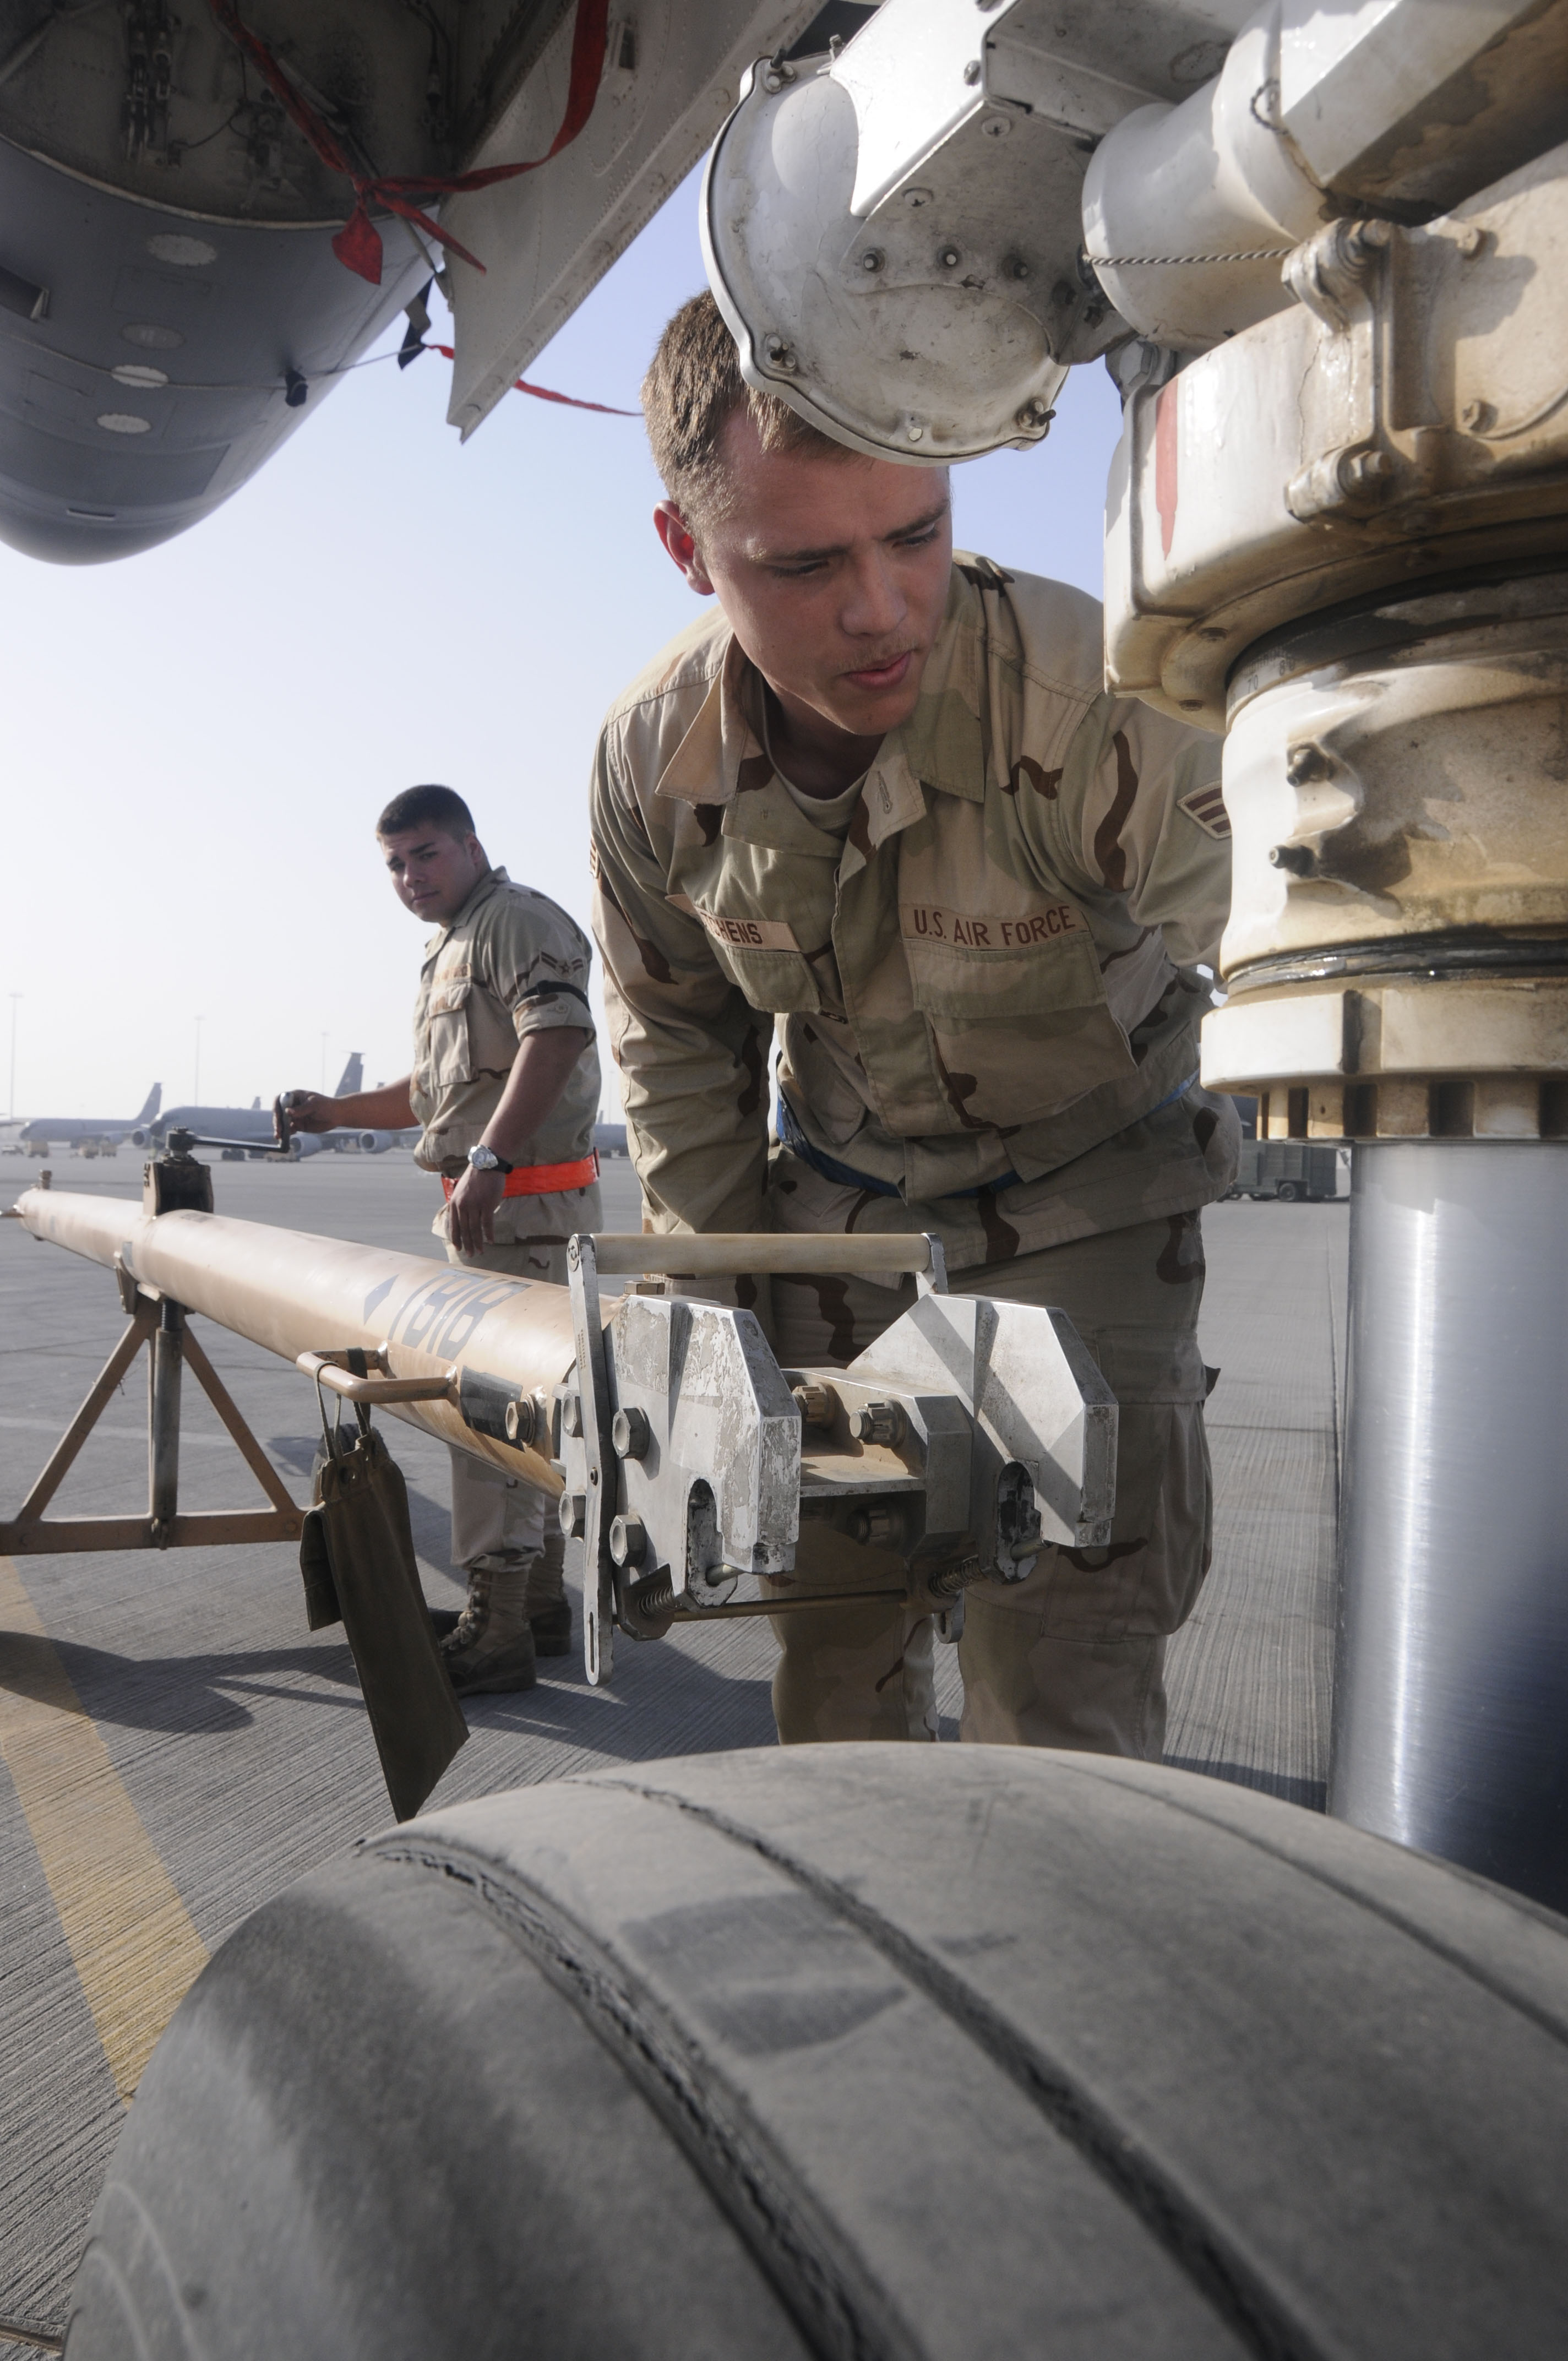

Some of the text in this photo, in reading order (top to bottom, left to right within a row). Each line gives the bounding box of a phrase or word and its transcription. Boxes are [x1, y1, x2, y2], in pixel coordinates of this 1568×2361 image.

[914, 906, 1076, 946] U.S. AIR FORCE
